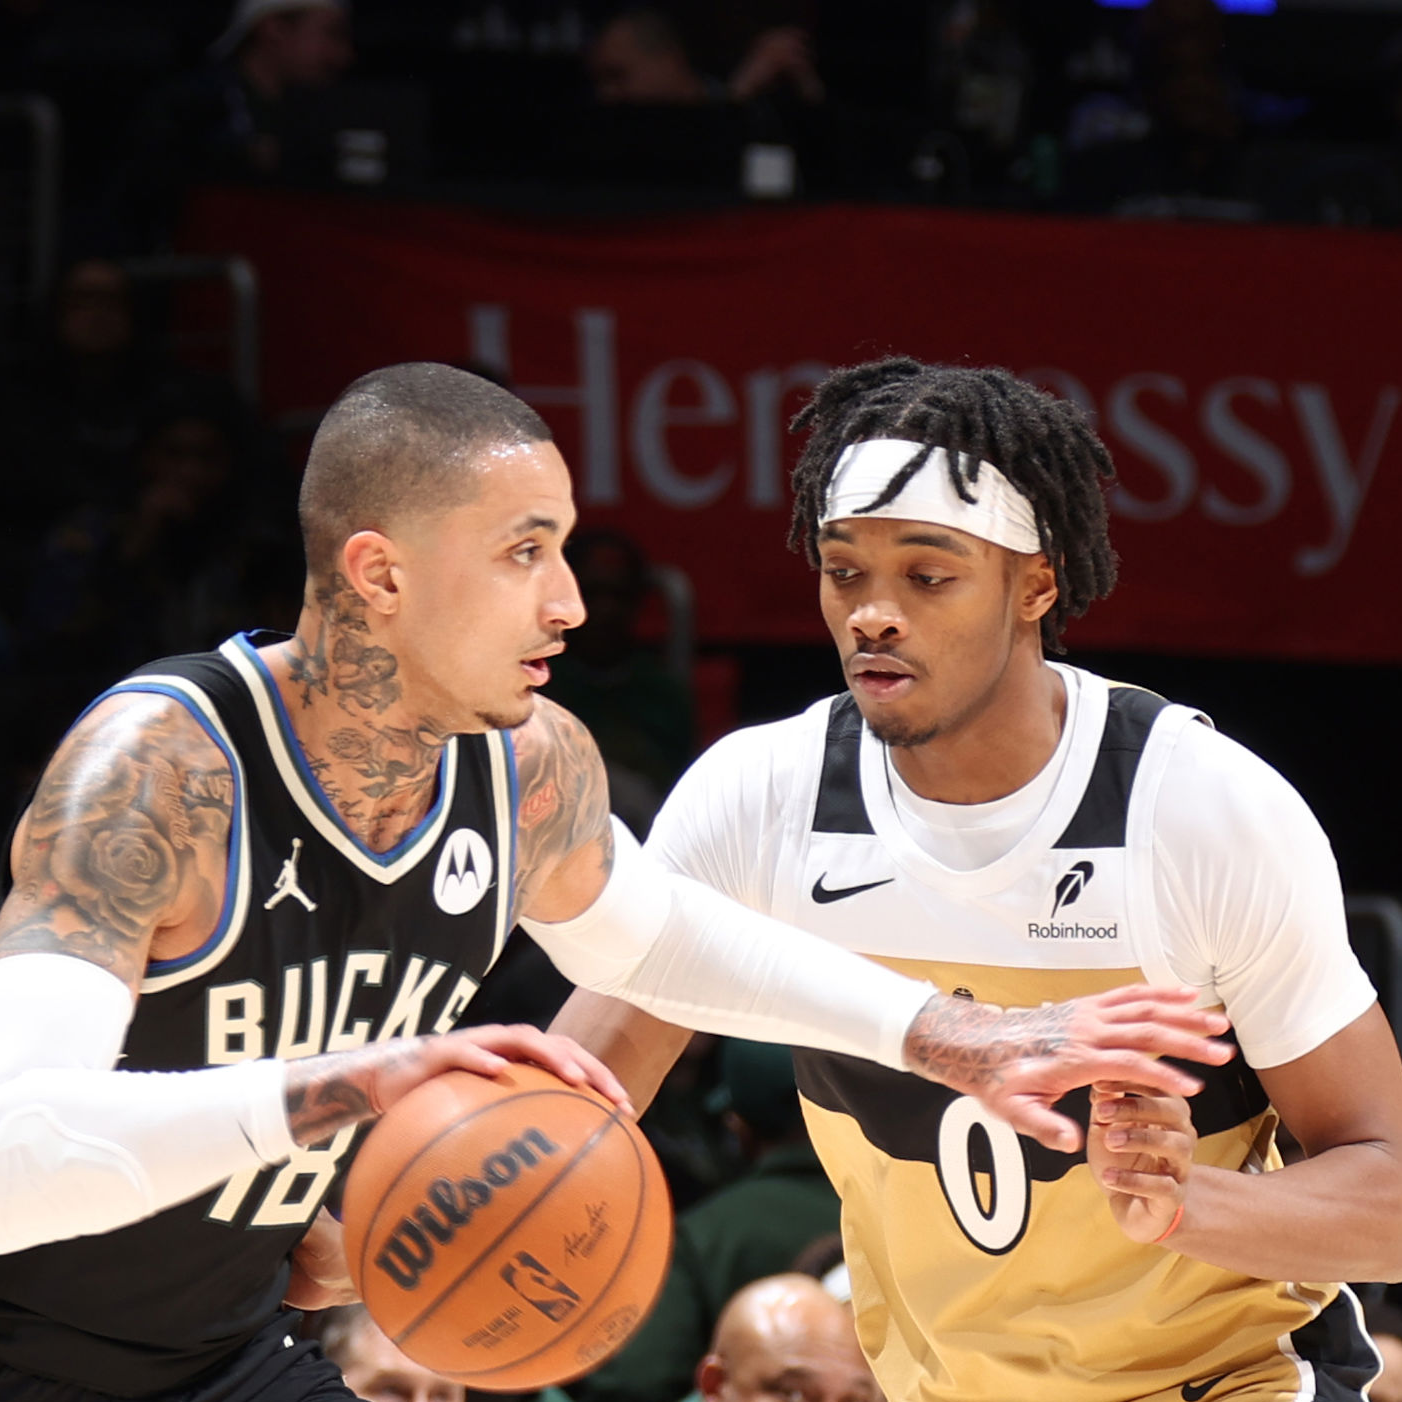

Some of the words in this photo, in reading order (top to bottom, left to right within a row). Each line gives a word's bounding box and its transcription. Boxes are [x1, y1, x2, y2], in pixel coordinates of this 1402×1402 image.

[1027, 922, 1118, 939] Robinhood
[374, 1126, 561, 1291] Wilson
[936, 1093, 1031, 1255] 0
